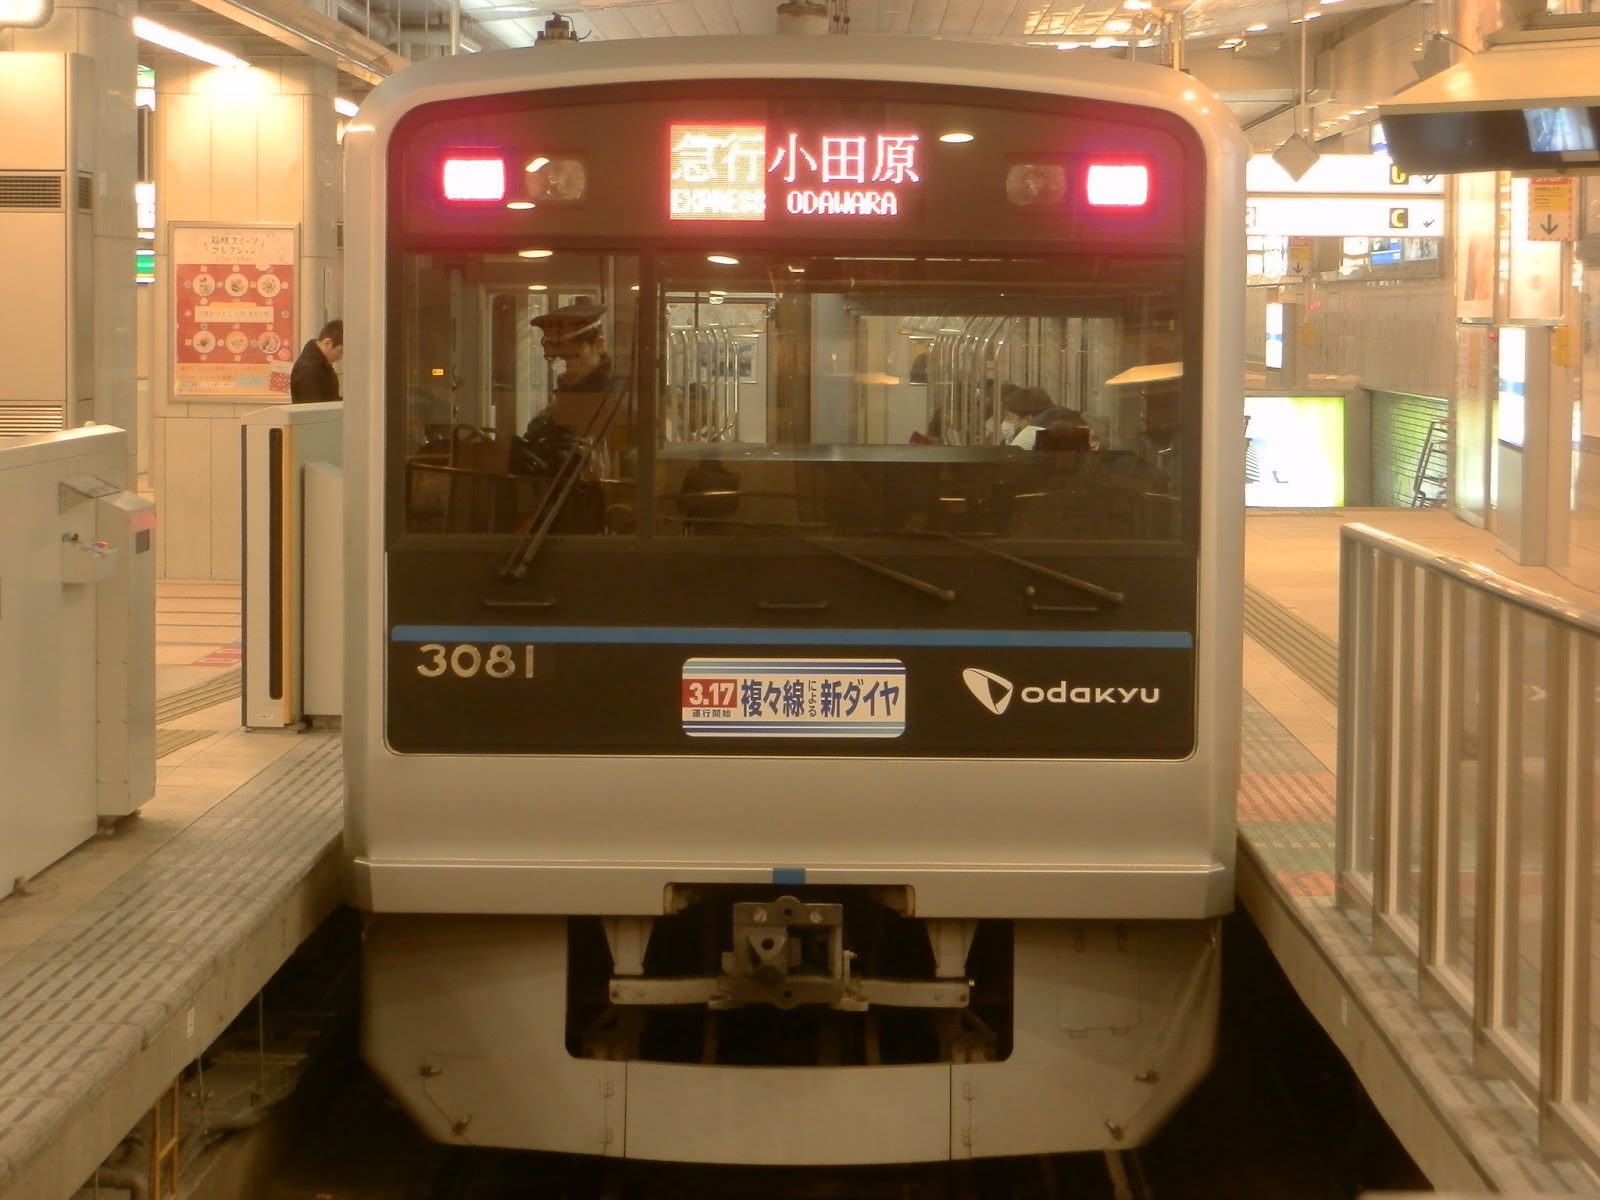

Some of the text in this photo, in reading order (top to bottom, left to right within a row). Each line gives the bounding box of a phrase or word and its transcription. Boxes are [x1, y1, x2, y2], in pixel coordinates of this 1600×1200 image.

[671, 132, 766, 183] 急行
[767, 133, 919, 183] 小田原
[786, 191, 898, 215] ODAWARA
[1391, 208, 1405, 228] C
[417, 643, 534, 678] 3081
[689, 682, 735, 706] 3.17
[1021, 680, 1160, 703] odakyu
[692, 708, 732, 718] 運行開始
